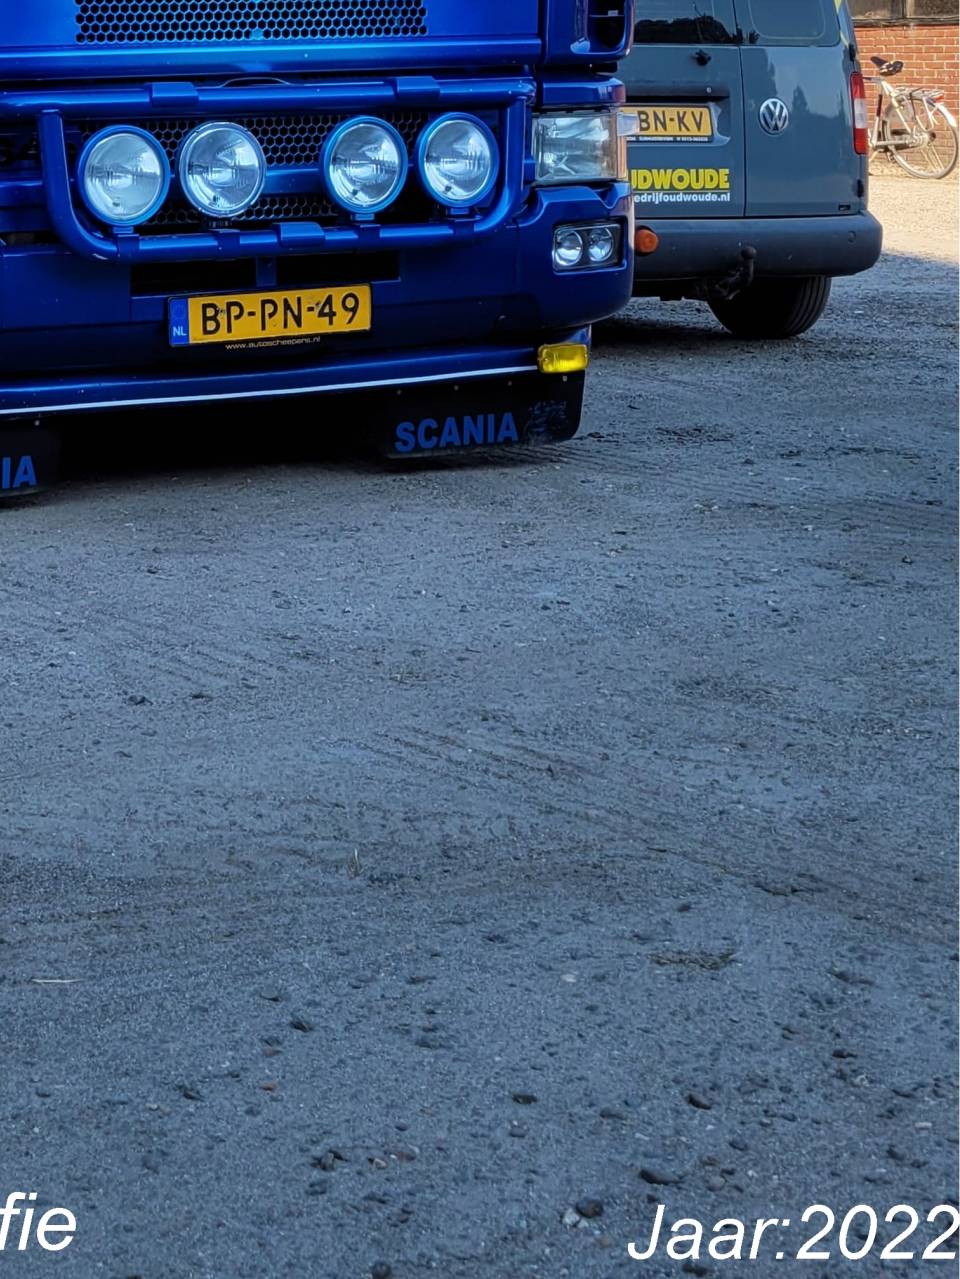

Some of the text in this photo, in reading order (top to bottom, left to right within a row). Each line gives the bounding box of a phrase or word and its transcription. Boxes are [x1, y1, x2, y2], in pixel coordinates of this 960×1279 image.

[172, 292, 360, 337] NL BP-PN-49
[395, 412, 519, 453] SCANIA
